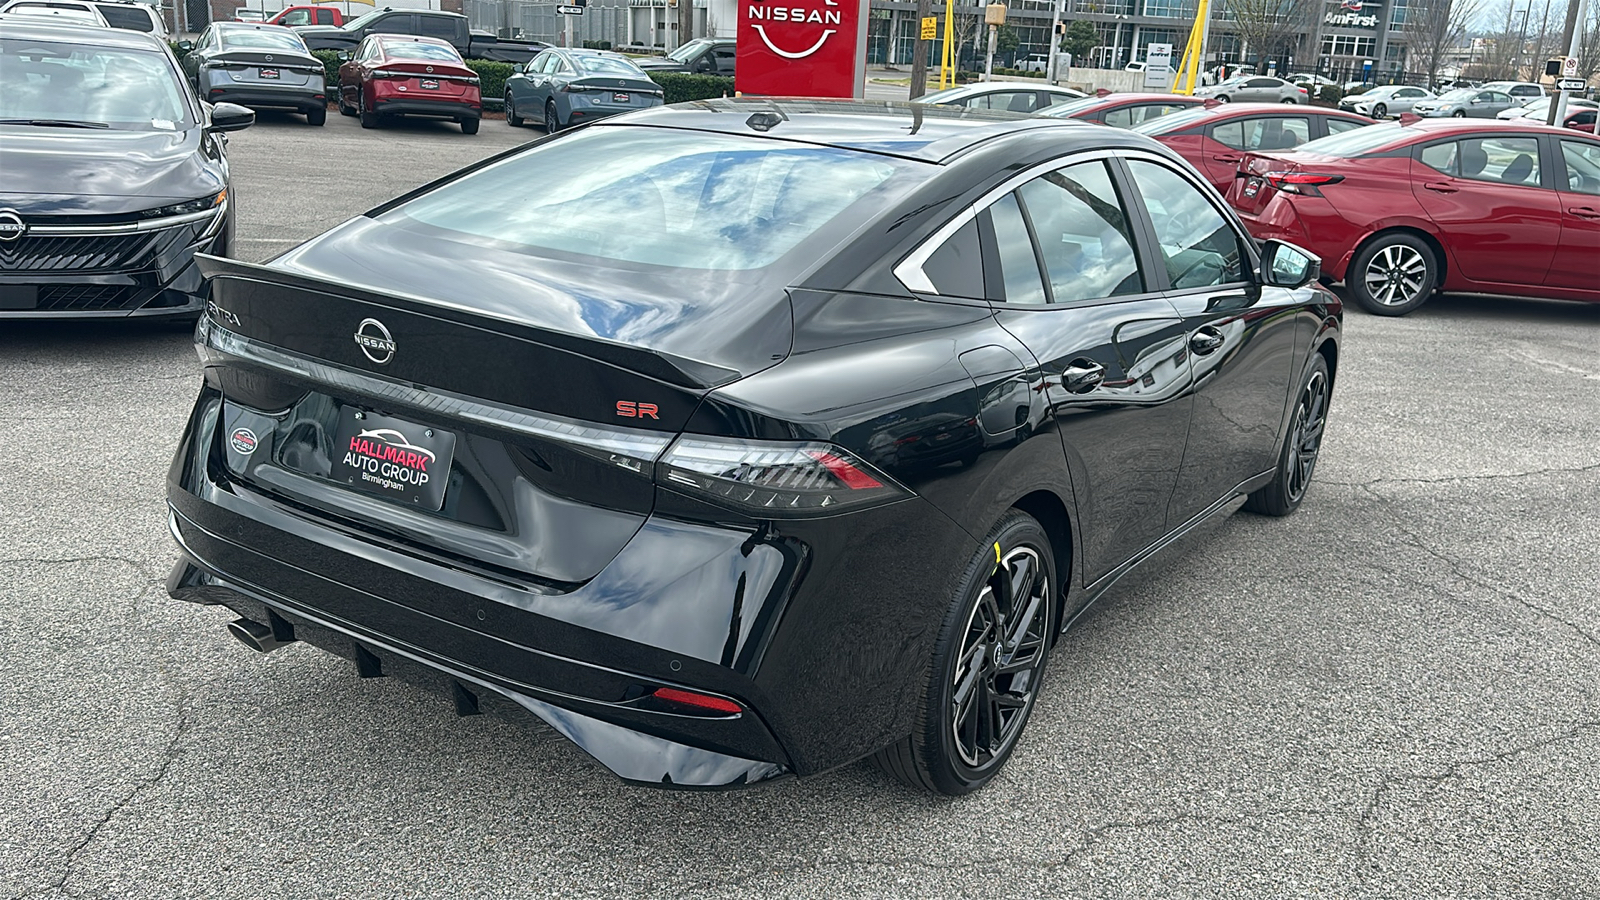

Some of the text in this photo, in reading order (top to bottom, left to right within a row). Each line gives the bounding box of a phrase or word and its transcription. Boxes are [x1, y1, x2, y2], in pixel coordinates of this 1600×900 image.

[748, 5, 841, 25] NISSAN
[1324, 11, 1377, 27] AmFirst
[354, 334, 395, 351] NISSAN
[616, 400, 660, 420] SR
[349, 436, 429, 472] HALLMARK
[342, 451, 429, 486] AUTO GROUP
[361, 472, 404, 492] Birmingham
